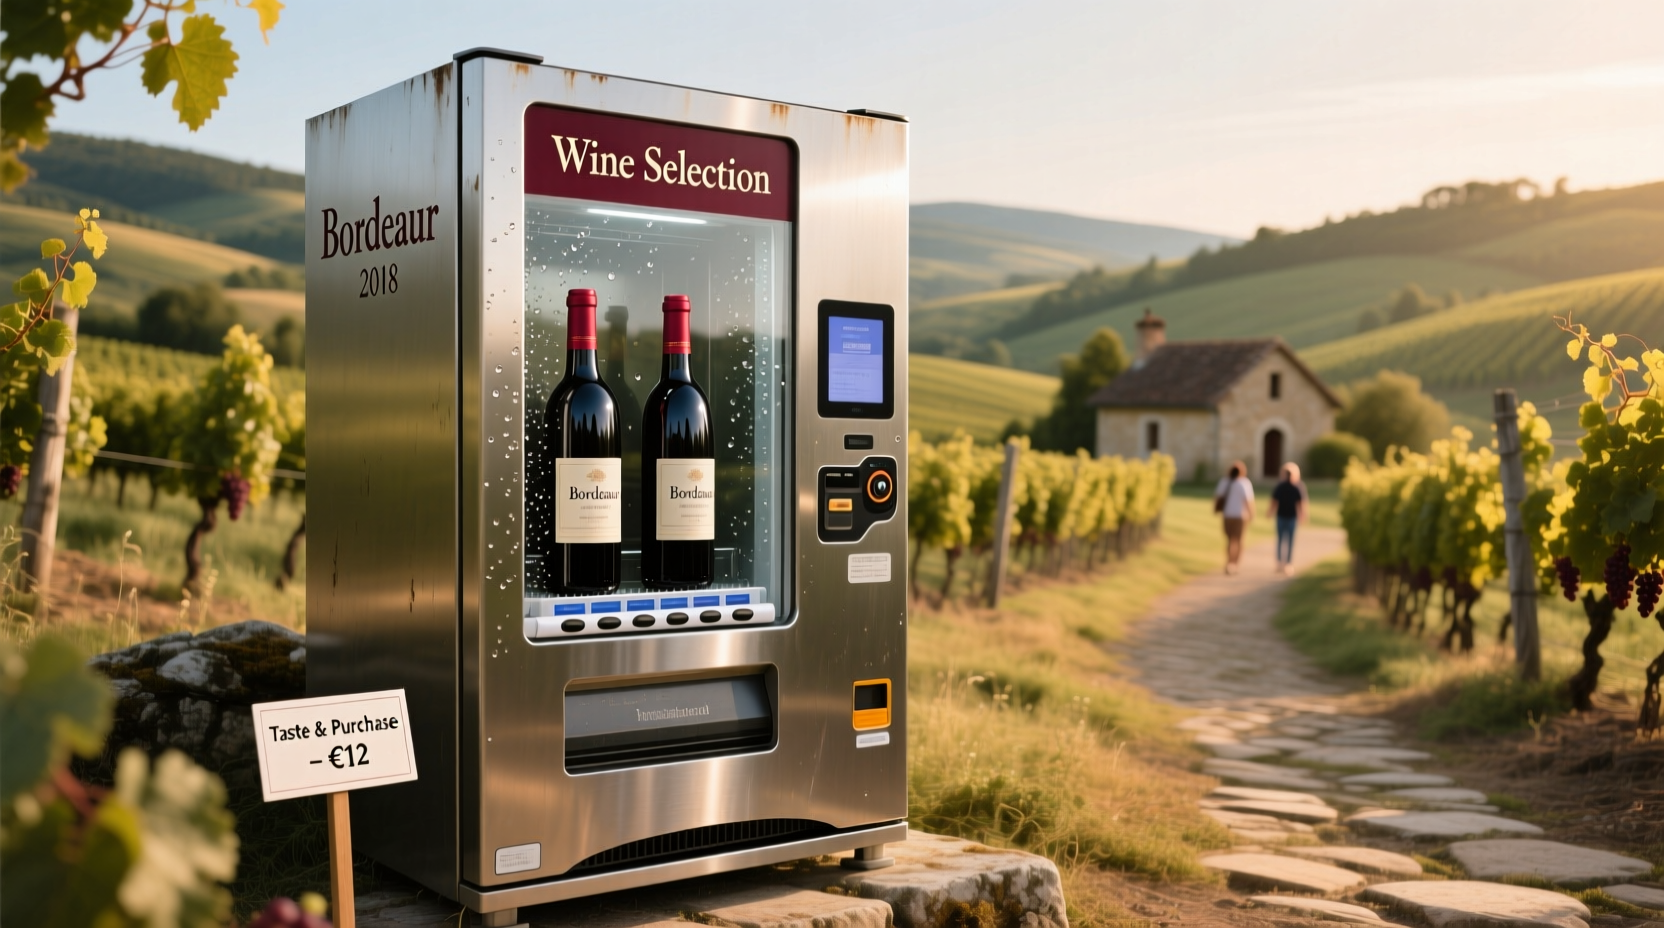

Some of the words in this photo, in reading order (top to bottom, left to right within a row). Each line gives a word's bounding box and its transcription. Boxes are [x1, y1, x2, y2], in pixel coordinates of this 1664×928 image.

[551, 134, 635, 179] Wine
[644, 146, 771, 195] Selection
[320, 195, 439, 260] Bordeaur
[359, 263, 398, 298] 2018
[269, 724, 310, 742] Taste
[315, 721, 327, 737] &
[331, 715, 399, 735] Purchase
[328, 743, 370, 769] €12
